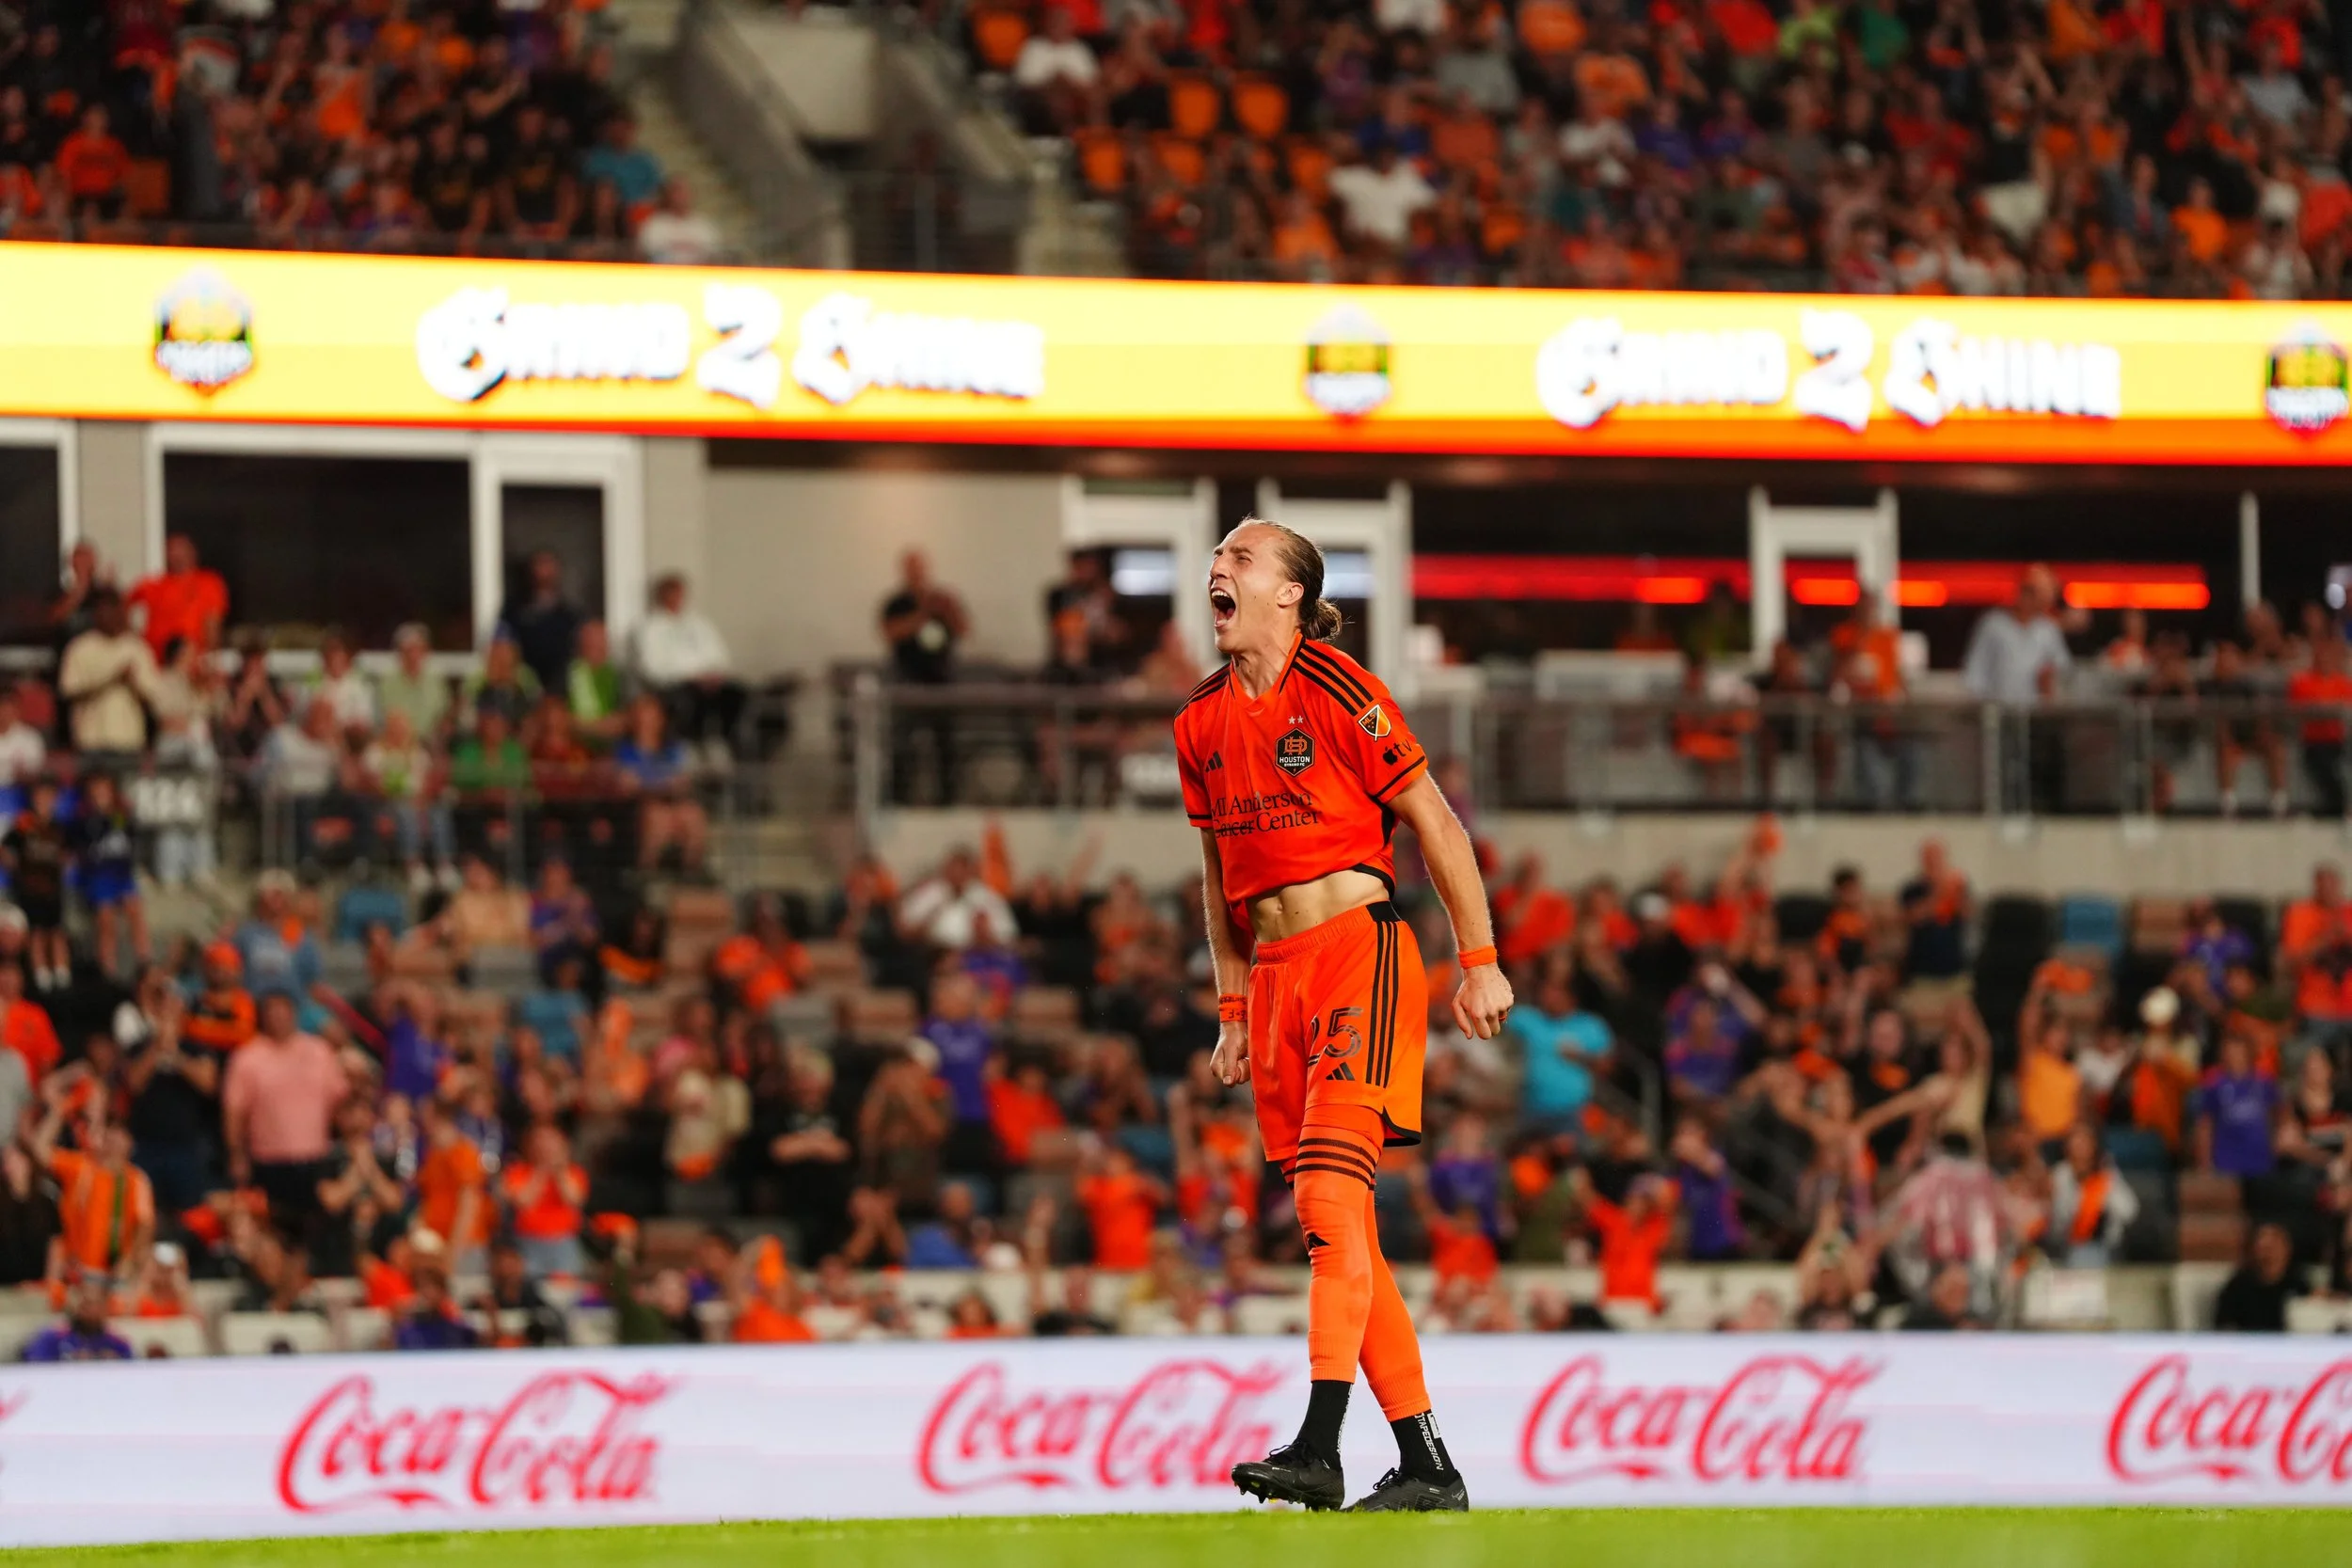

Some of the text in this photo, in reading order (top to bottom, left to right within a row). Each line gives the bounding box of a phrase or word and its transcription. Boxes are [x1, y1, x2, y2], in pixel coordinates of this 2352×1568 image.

[697, 282, 782, 408] 2
[1794, 307, 1873, 431] 2
[1361, 712, 1375, 726] MLS
[1230, 791, 1312, 815] Anderson
[1256, 810, 1322, 832] Center
[276, 1370, 685, 1513] Coca-Cola
[1418, 1415, 1444, 1471] TAPEDESIGN
[1519, 1353, 1891, 1486] Coca-Cola
